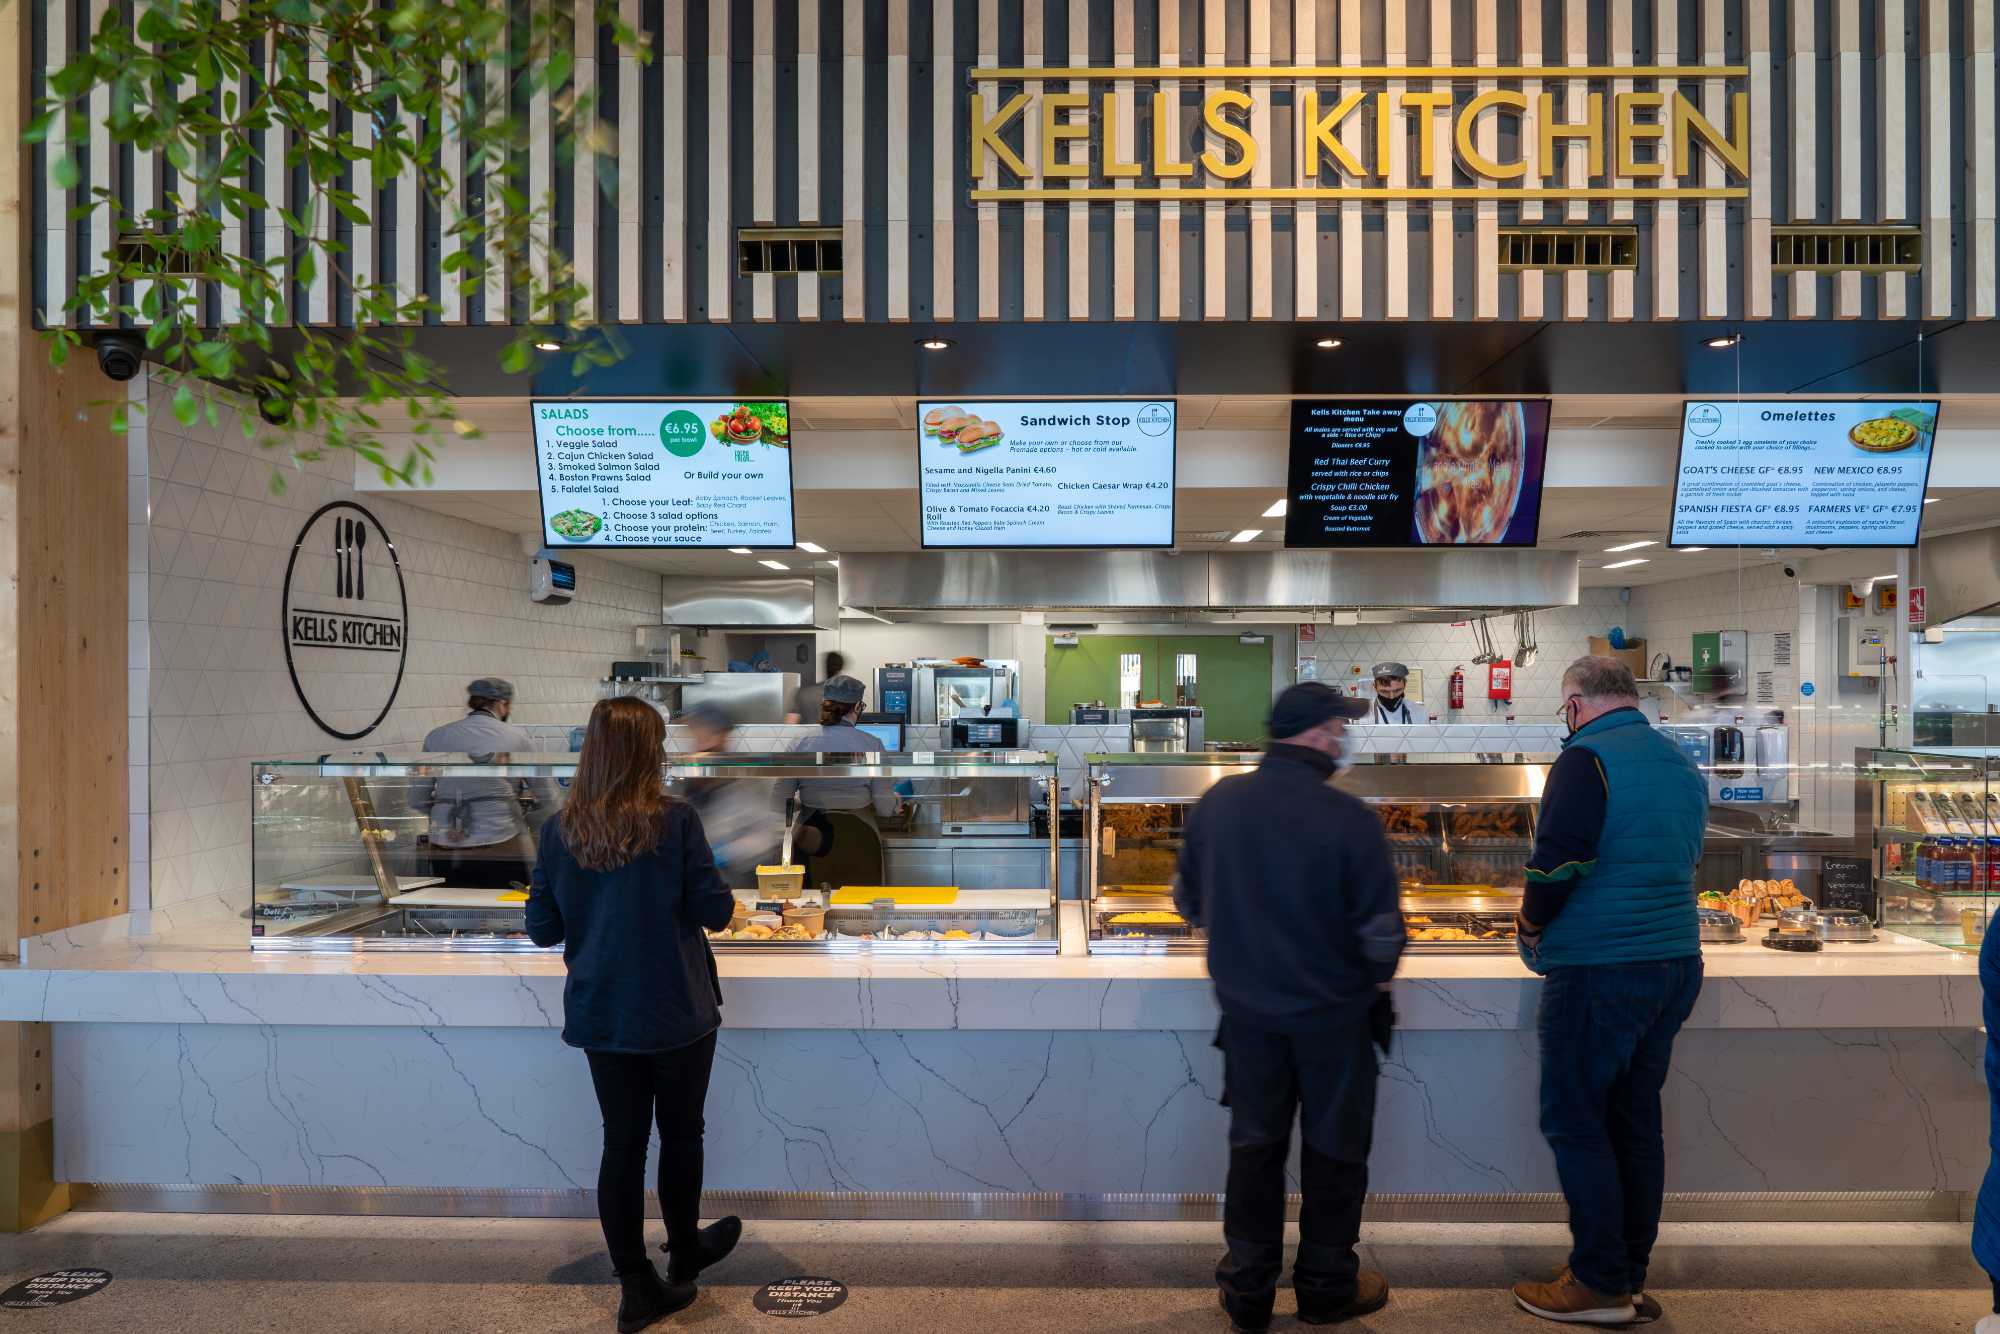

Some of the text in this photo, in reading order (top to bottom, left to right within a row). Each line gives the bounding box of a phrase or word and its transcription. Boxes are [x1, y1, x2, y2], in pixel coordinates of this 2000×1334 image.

[971, 89, 1749, 181] KELLS KITCHEN
[541, 409, 589, 420] SALADS
[1761, 410, 1836, 422] Omelettes
[1021, 415, 1091, 426] Sandwich
[1096, 415, 1130, 428] Stop
[556, 425, 604, 437] Choose
[665, 423, 698, 434] €6.95
[547, 440, 618, 449] 1. Veggie Salad
[547, 452, 654, 461] 2. Cajun Chicken Salad
[548, 463, 660, 471] 3. Smoked Salmon Salad
[1314, 458, 1391, 467] Red Thai Beef Curry
[957, 466, 973, 474] and
[975, 466, 1004, 475] Nigella
[1006, 466, 1031, 474] Panini
[1033, 466, 1057, 474] €4.60
[1371, 470, 1389, 478] chips
[1683, 466, 1718, 474] GOAT'S
[1720, 466, 1756, 474] CHEESE
[1777, 466, 1803, 475] €8.95
[1814, 466, 1902, 475] NEW MEXICO €8.95
[559, 474, 589, 482] Boston
[684, 471, 695, 480] Or
[697, 471, 719, 480] Build
[721, 473, 742, 481] your
[561, 485, 591, 493] Falafel
[593, 485, 619, 493] Salad
[1057, 482, 1090, 490] Chicken
[1092, 482, 1120, 490] Caesar
[1122, 482, 1143, 491] Wrap
[1145, 482, 1169, 490] €4.20
[1311, 483, 1390, 492] Crispy Chilli Chicken
[1314, 494, 1345, 502] vegetable
[602, 498, 610, 506] 1.
[612, 498, 647, 506] Choose
[649, 499, 669, 508] your
[671, 498, 694, 506] Leaf:
[926, 505, 947, 513] Olive
[958, 505, 989, 513] Tomato
[991, 505, 1025, 513] Focaccia
[1027, 505, 1050, 513] €4.20
[1330, 504, 1347, 512] Soup
[1678, 505, 1718, 513] SPANISH
[1721, 505, 1753, 513] FIESTA
[1774, 505, 1800, 513] €8.95
[1808, 505, 1851, 513] FARMERS
[1891, 505, 1917, 513] €7.95
[602, 512, 718, 521] 2. Choose 3 salad options
[926, 513, 942, 521] Roll
[604, 524, 612, 532] 3.
[614, 524, 649, 532] Choose
[651, 525, 671, 533] your
[674, 524, 708, 533] protein:
[292, 615, 401, 648] KELLS KITCHEN
